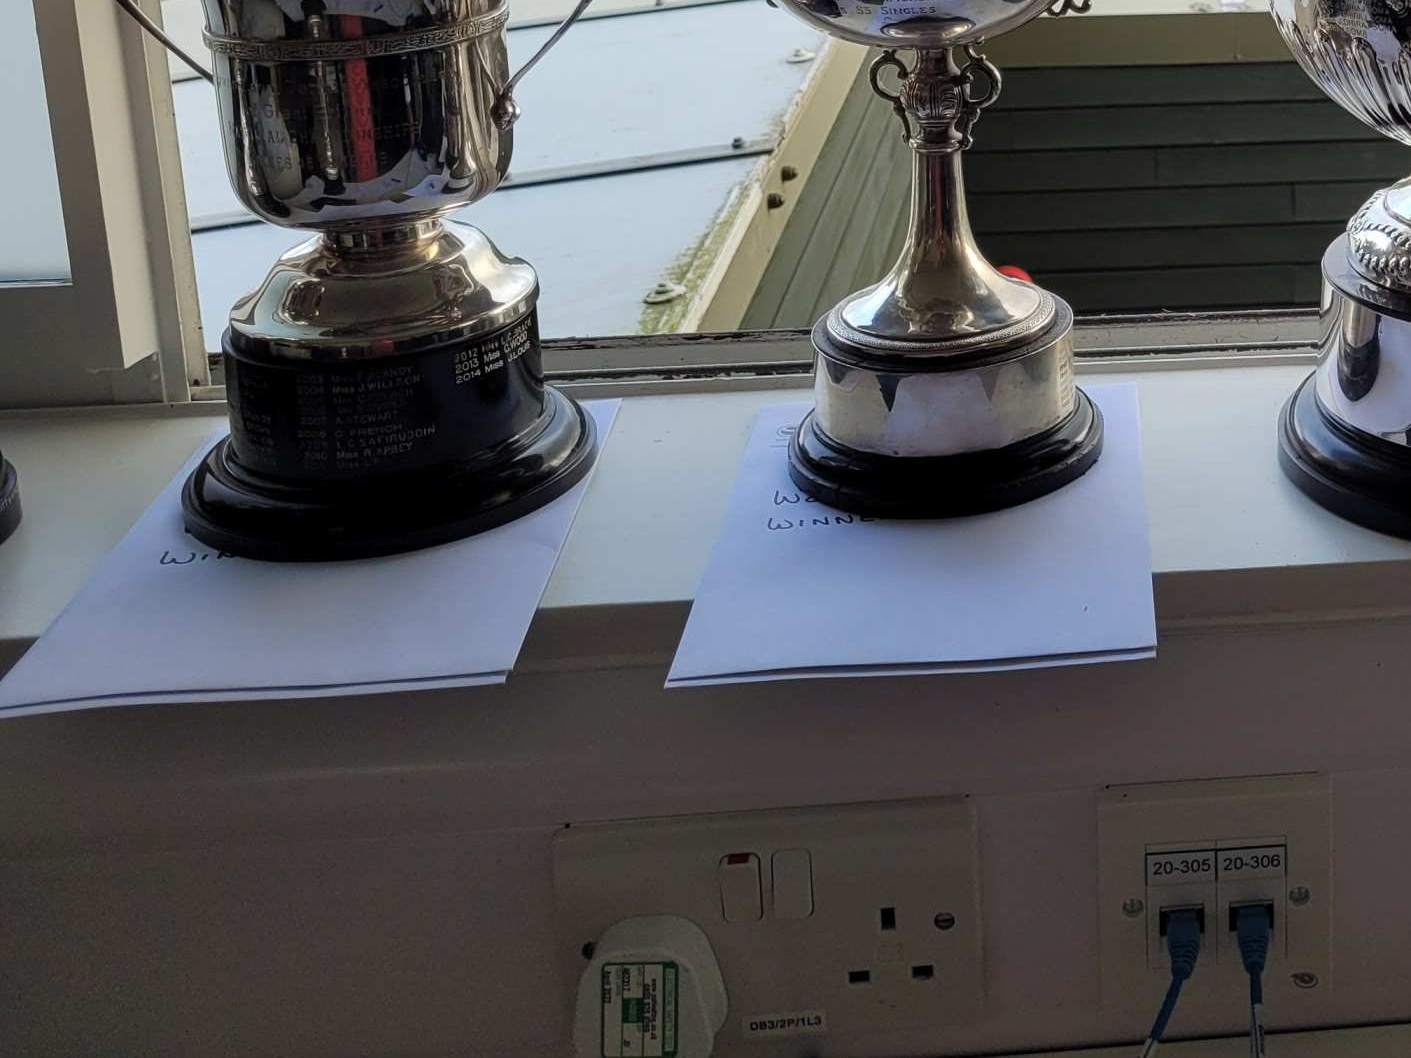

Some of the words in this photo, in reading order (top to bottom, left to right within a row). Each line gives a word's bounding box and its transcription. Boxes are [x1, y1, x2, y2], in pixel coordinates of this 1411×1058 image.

[880, 6, 937, 15] SINGLES
[455, 358, 479, 374] 2013
[456, 369, 481, 384] 2014
[1153, 858, 1211, 875] 20-305
[1223, 854, 1281, 871] 20-306
[750, 1016, 822, 1031] DB3/2P/1L3
